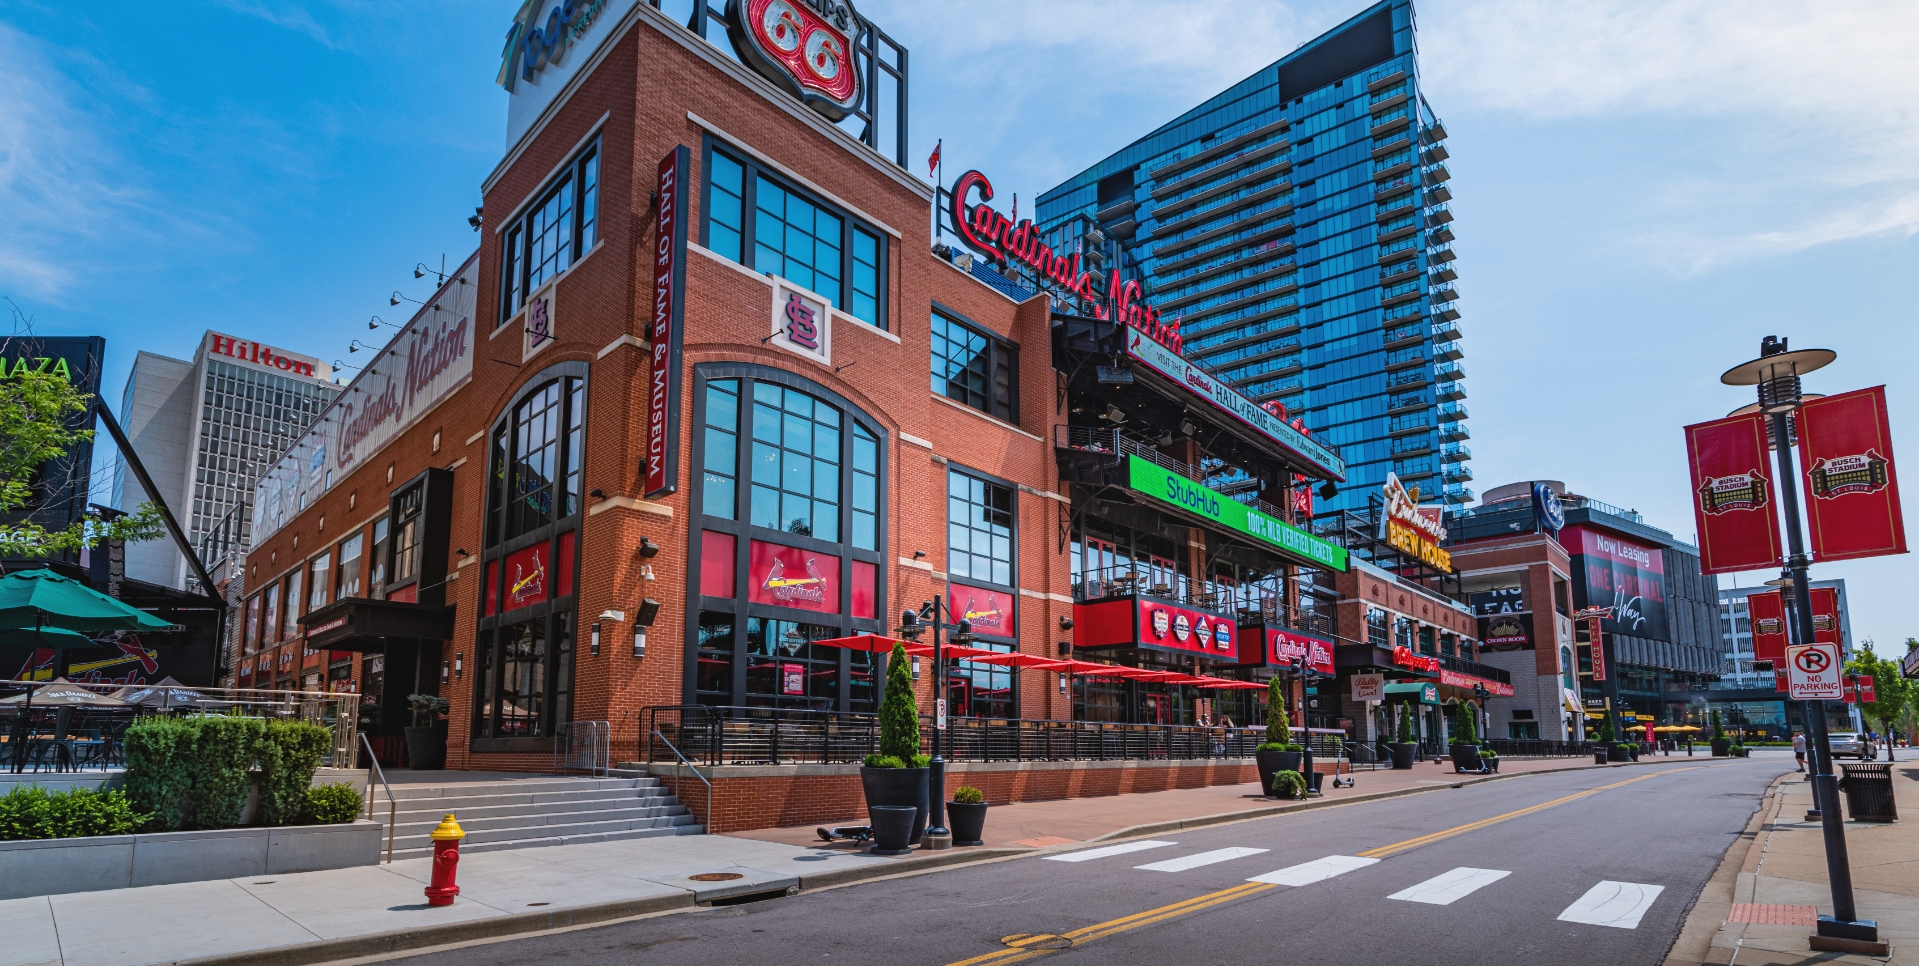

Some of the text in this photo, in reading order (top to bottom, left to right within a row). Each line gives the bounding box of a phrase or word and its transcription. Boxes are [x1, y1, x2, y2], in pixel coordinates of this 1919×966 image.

[763, 0, 843, 80] 66
[949, 170, 1184, 358] Cardinals Nation
[650, 165, 673, 479] HALL OF FAME & MUSEUM
[211, 333, 313, 377] Hilton
[337, 371, 398, 470] Cardinals
[395, 315, 467, 425] Nation
[1156, 352, 1170, 368] VISIT
[1171, 360, 1182, 375] THE
[1185, 365, 1212, 395] Cardinals
[1215, 384, 1240, 414] HALL
[1240, 402, 1246, 417] of
[1246, 403, 1269, 431] FAME
[1269, 421, 1290, 441] PRESENTED
[1827, 462, 1867, 474] STADIUM
[1831, 457, 1862, 468] BUSCH
[1166, 475, 1220, 517] StubHub
[1715, 481, 1749, 492] STADIUM
[1718, 476, 1745, 486] BUSCH
[1831, 488, 1843, 496] ST.
[1246, 510, 1333, 564] 100% MLB VERIFIED TICKETS
[1389, 520, 1452, 574] BREW HOUSE
[1596, 534, 1650, 568] Now Leasing
[772, 584, 826, 603] Cardinals
[1588, 564, 1664, 603] ONE CARDINAL
[970, 615, 1002, 630] ardinals
[1614, 585, 1646, 631] Way
[1276, 633, 1332, 667] Cardinals Nation
[1486, 635, 1526, 644] CROWN ROOM
[1590, 617, 1601, 678] BREW HOUSE
[1354, 676, 1380, 688] Bally
[1358, 689, 1377, 698] Live!
[1793, 682, 1838, 691] PARKING
[1807, 674, 1822, 683] NO
